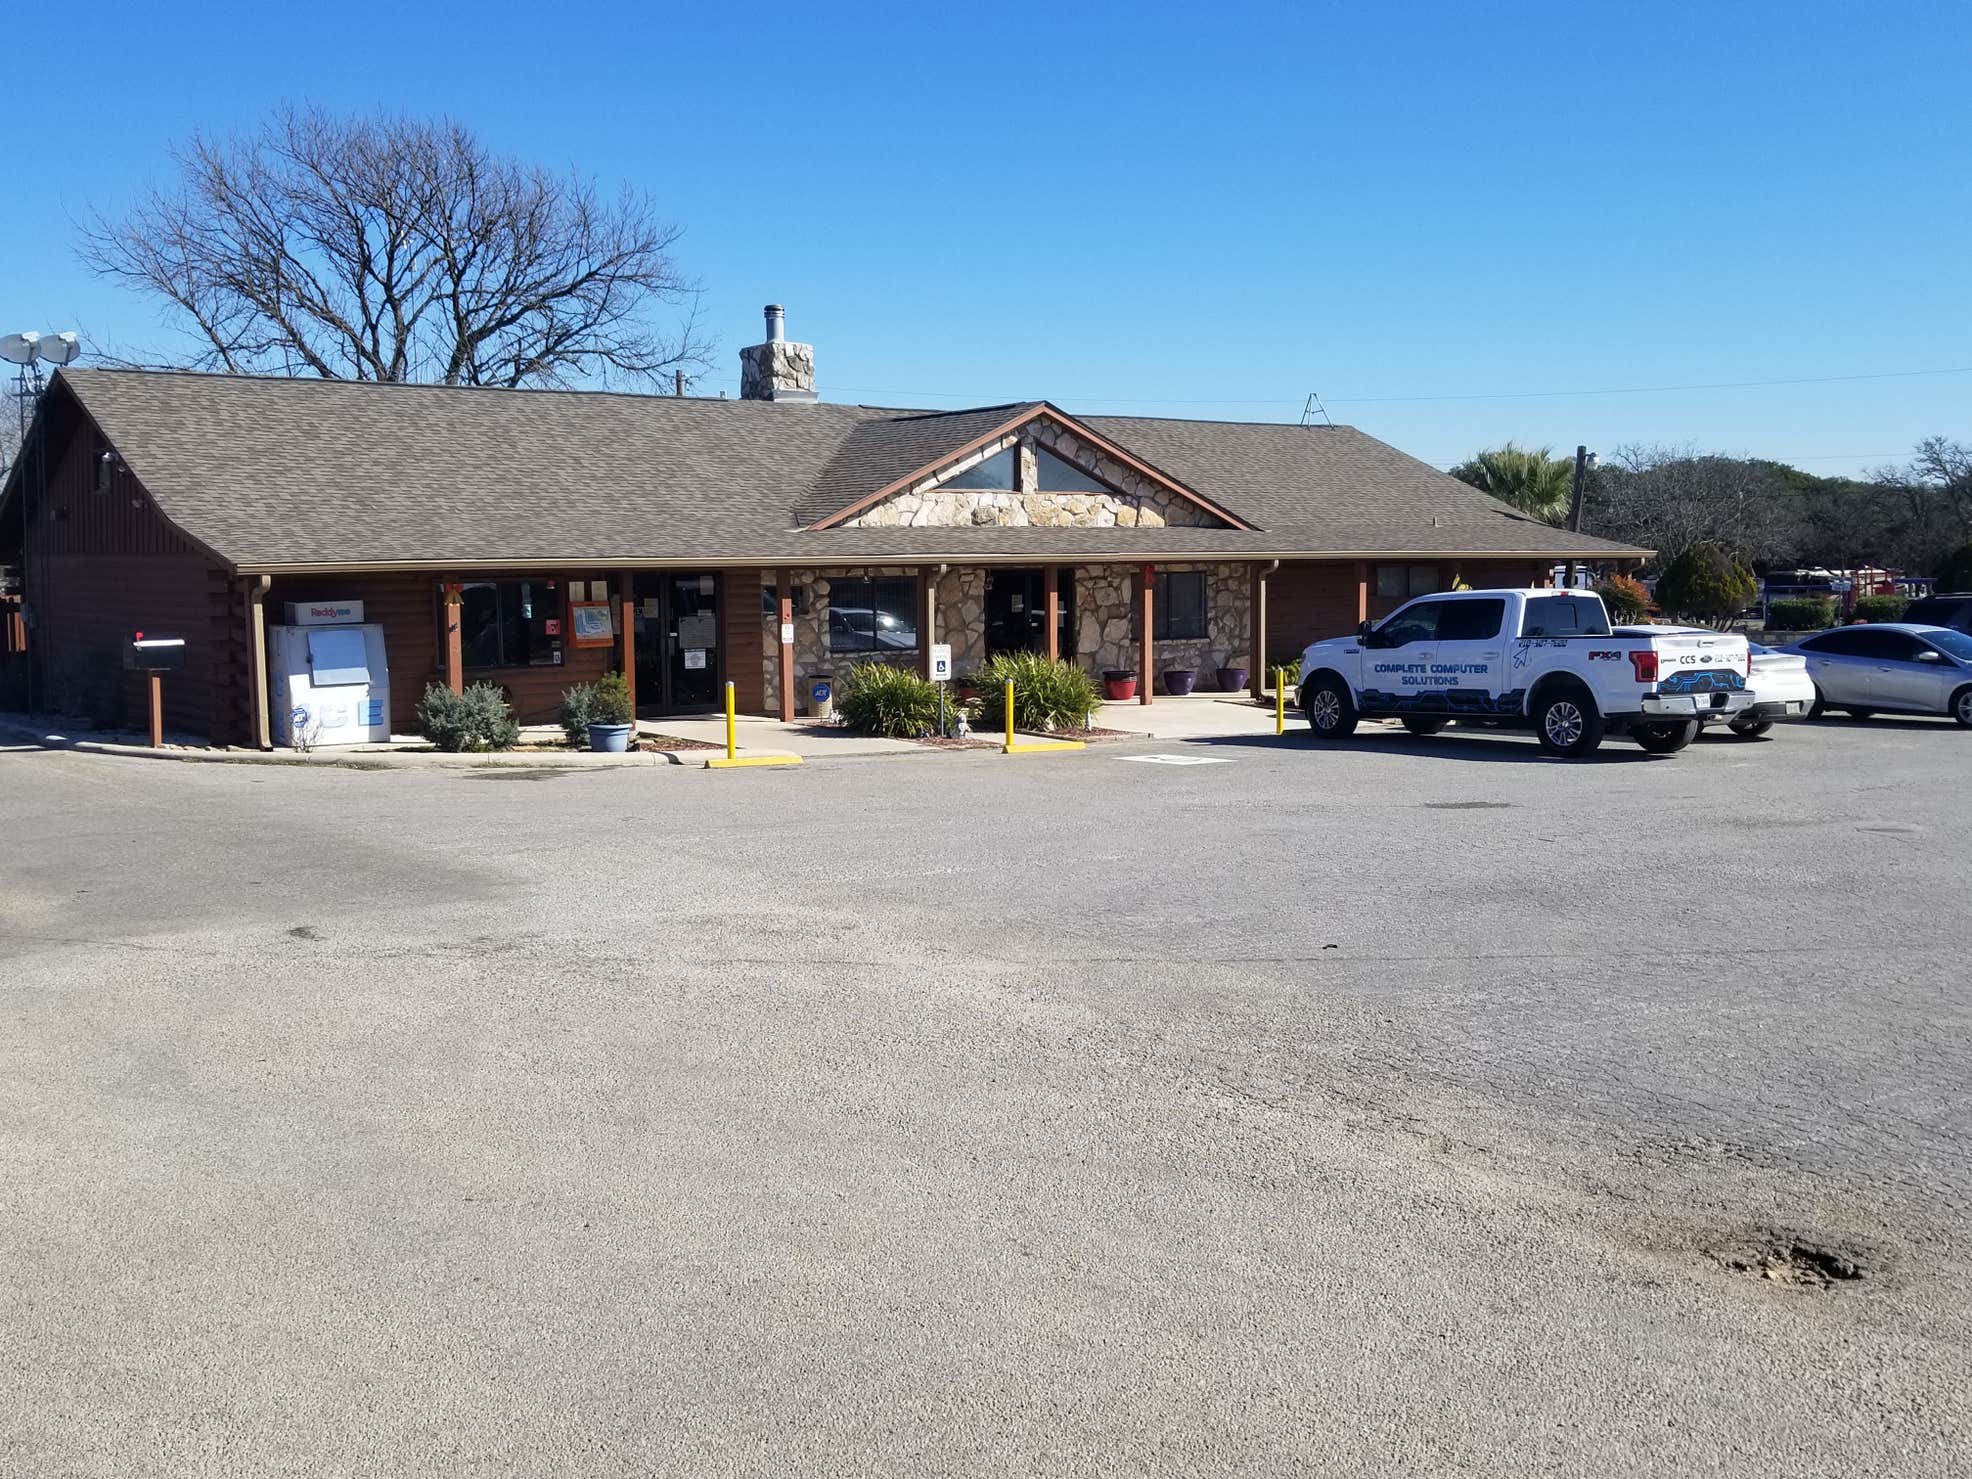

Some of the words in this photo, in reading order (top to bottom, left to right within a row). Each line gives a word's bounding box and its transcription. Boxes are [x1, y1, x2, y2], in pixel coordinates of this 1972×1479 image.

[1588, 651, 1622, 661] FX4
[1680, 655, 1696, 664] CCS
[1374, 663, 1427, 674] COMPLETE
[1430, 663, 1489, 674] COMPUTER
[1401, 675, 1459, 686] SOLUTIONS
